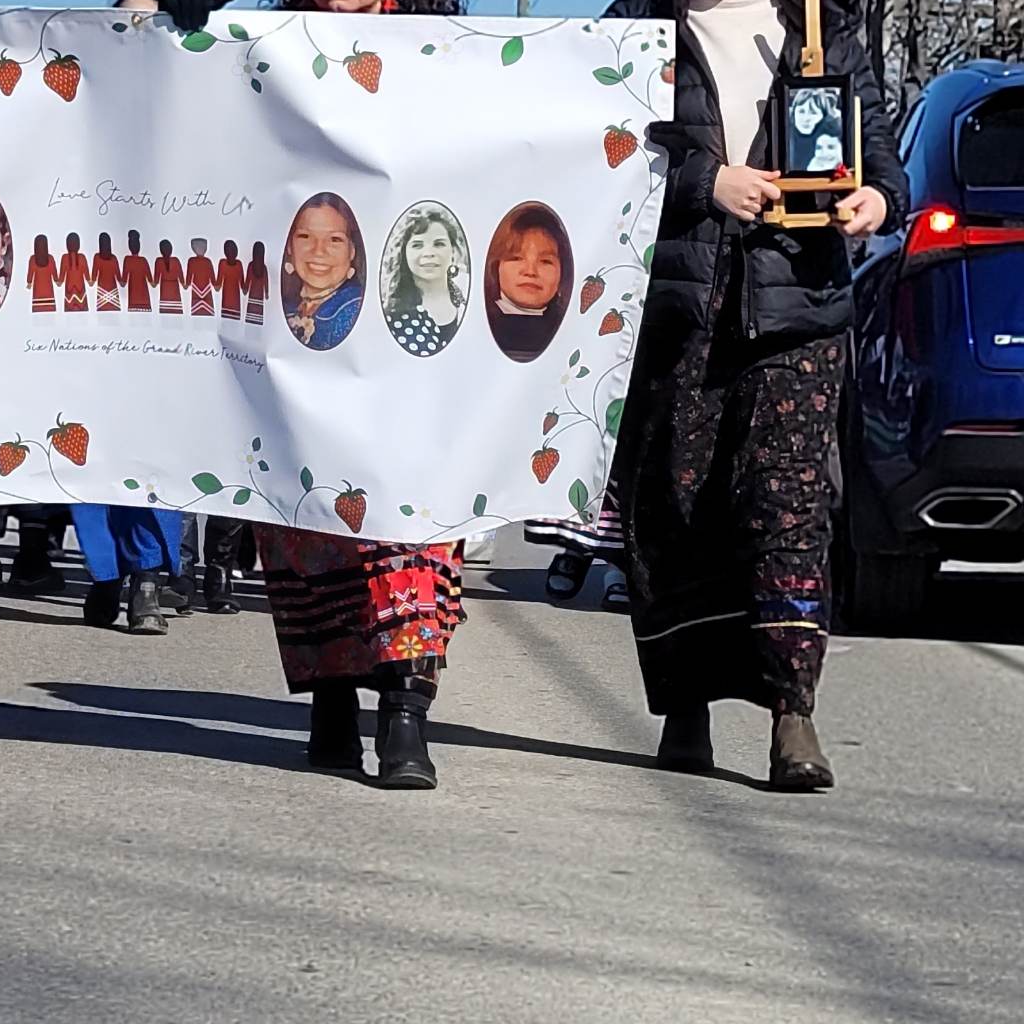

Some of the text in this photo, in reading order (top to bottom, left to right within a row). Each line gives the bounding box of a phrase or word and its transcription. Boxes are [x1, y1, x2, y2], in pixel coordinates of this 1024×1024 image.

[48, 176, 255, 217] Love Starts With Us
[23, 337, 266, 374] Six Nations of the Grand River Territory
